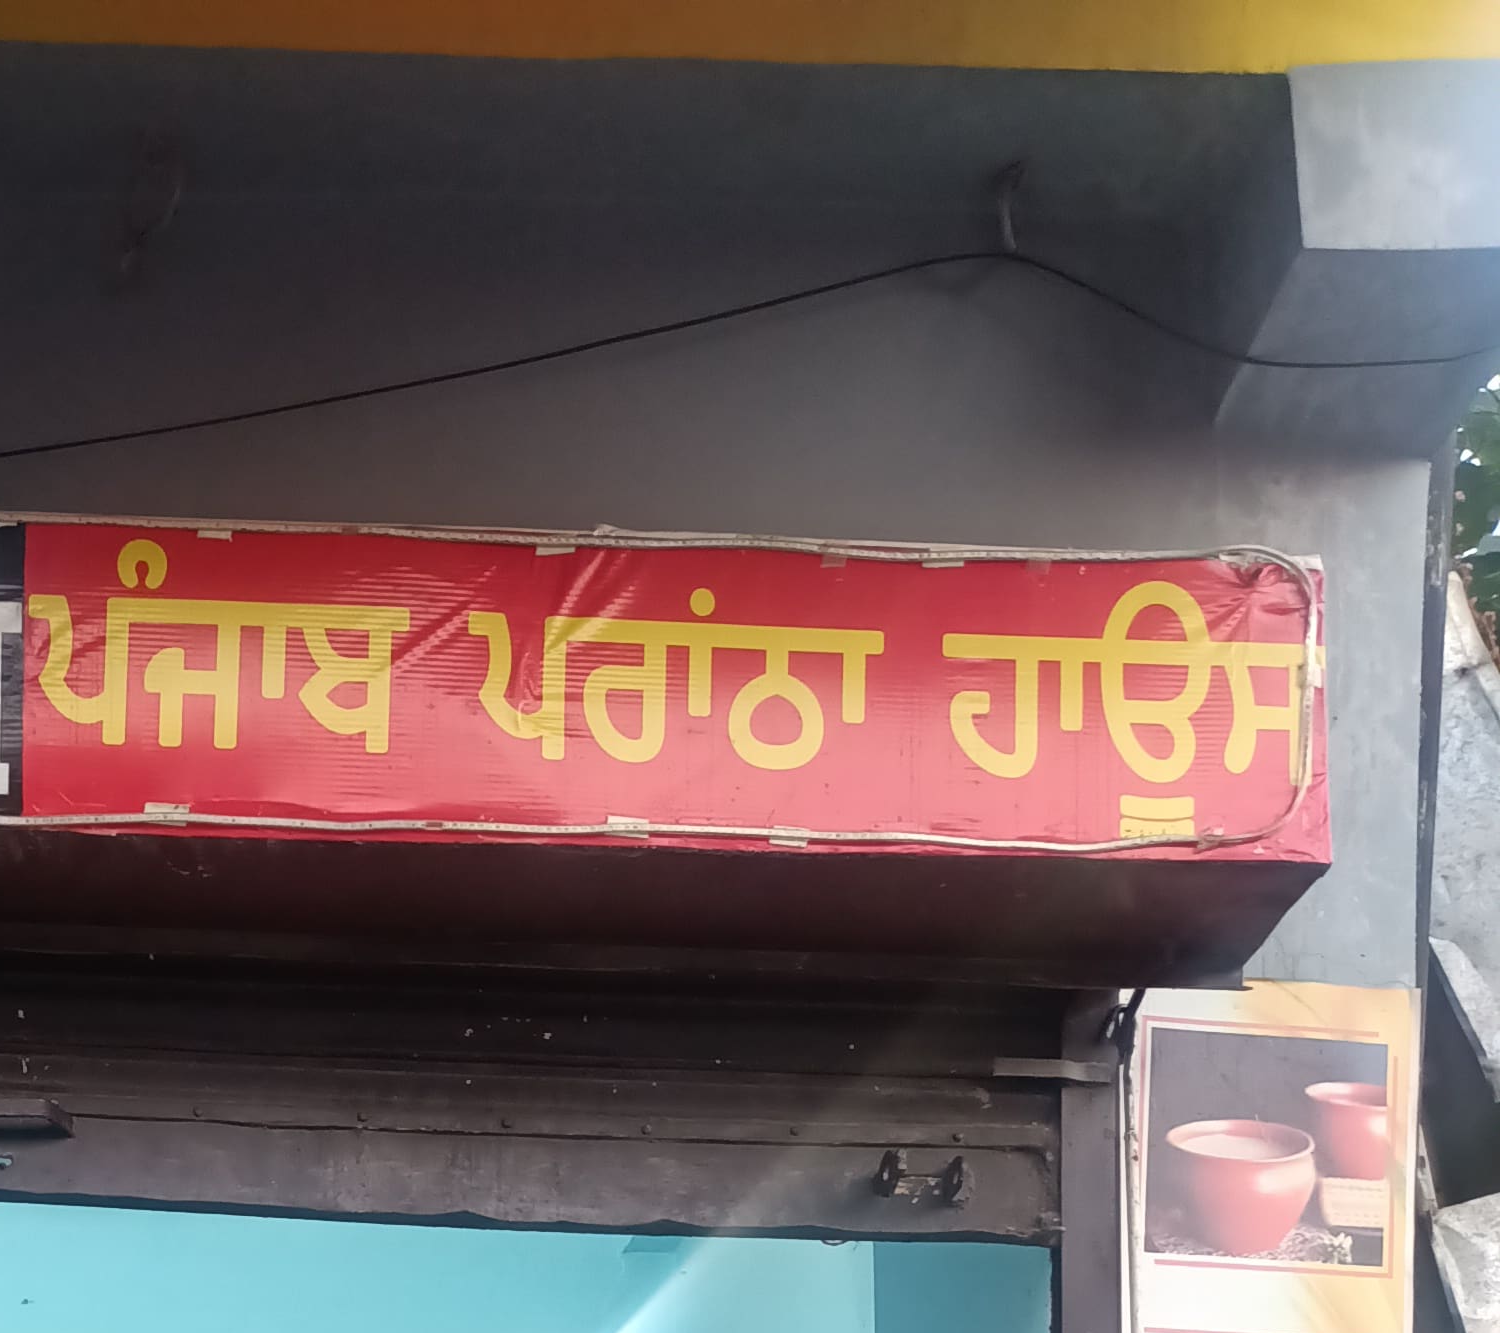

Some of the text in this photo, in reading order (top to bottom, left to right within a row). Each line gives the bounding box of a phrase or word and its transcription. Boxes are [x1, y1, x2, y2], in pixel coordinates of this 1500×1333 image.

[29, 540, 1322, 838] ਪੰਜਾਬ ਪਰਾਂਠਾ ਹਾਊਸ
